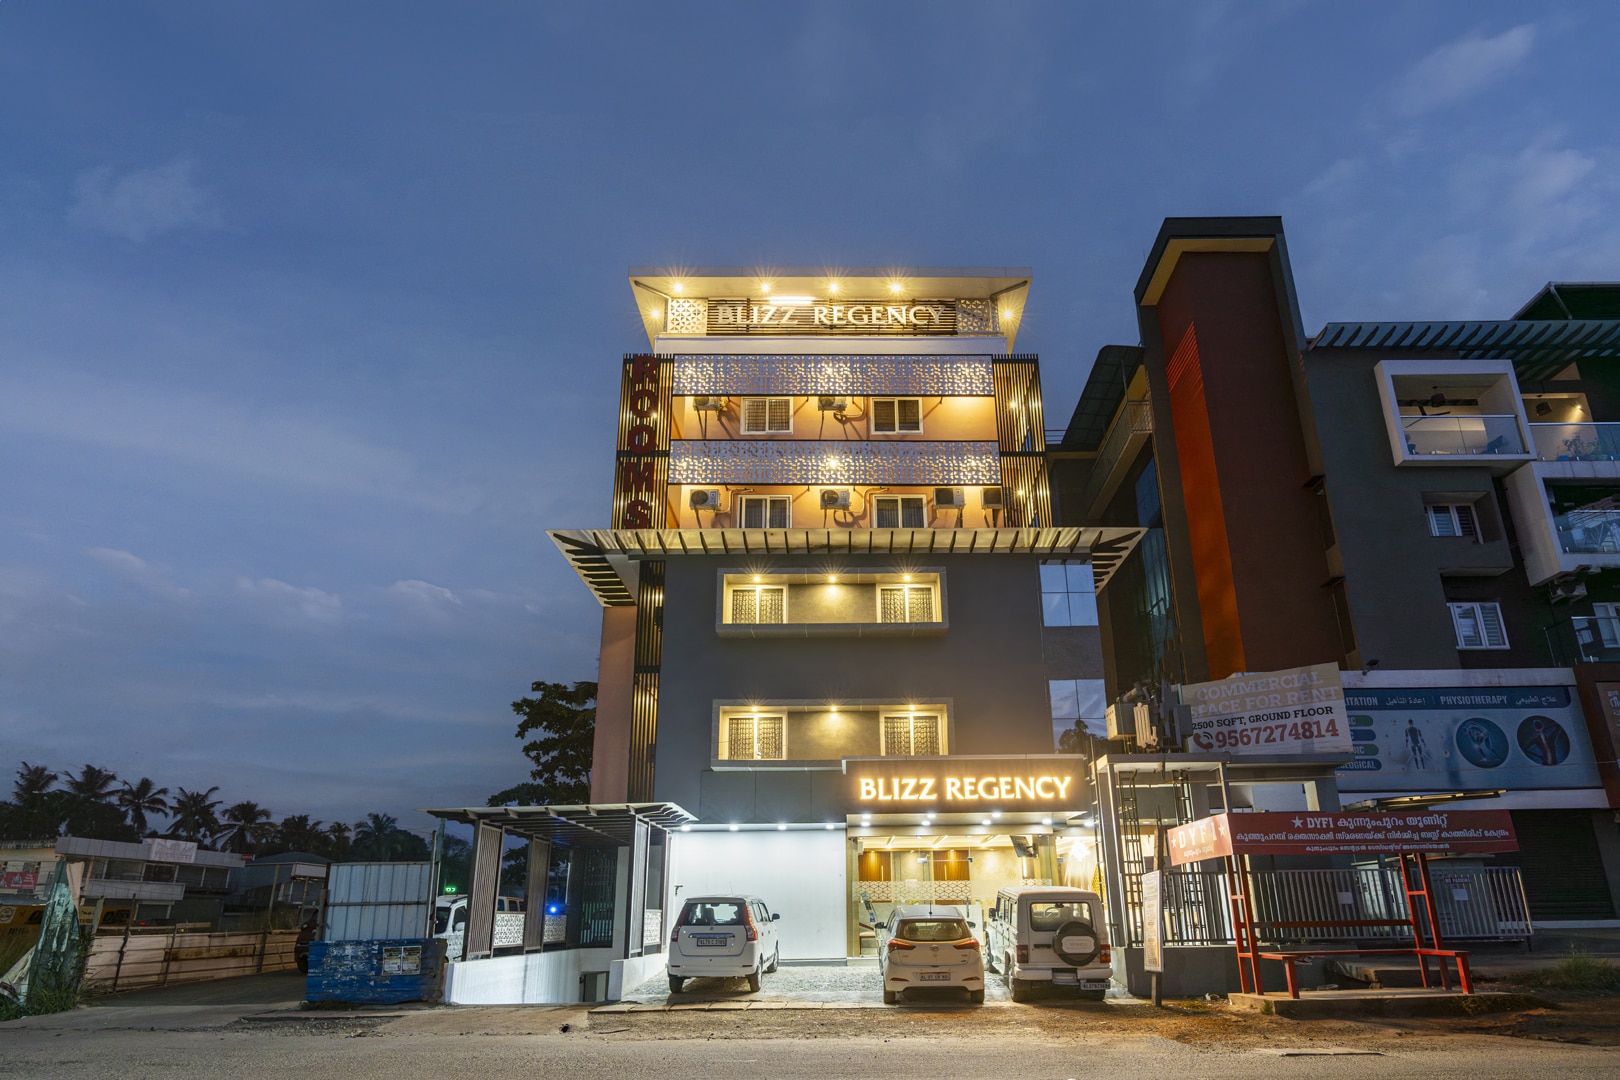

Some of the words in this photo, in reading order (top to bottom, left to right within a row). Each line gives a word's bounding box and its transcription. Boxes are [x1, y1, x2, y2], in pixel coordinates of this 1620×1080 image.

[717, 305, 800, 324] BLIZZ
[813, 305, 946, 325] REGENCY
[623, 354, 658, 529] ROOMS
[1196, 671, 1324, 701] COMMERCIAL
[1191, 700, 1241, 717] SPACE
[1245, 692, 1282, 710] FOR
[1286, 686, 1339, 704] RENT
[1440, 695, 1508, 705] PHYSIOTHERAPY
[1192, 720, 1214, 730] 2500
[1216, 716, 1247, 728] SQFT,
[1249, 711, 1291, 723] GROUND
[1293, 706, 1333, 718] FLOOR
[1215, 719, 1339, 749] 9567274814
[859, 777, 938, 800] BLIZZ
[945, 776, 1072, 800] REGENCY
[1178, 821, 1217, 849] DYFI
[1306, 817, 1334, 829] DYFI
